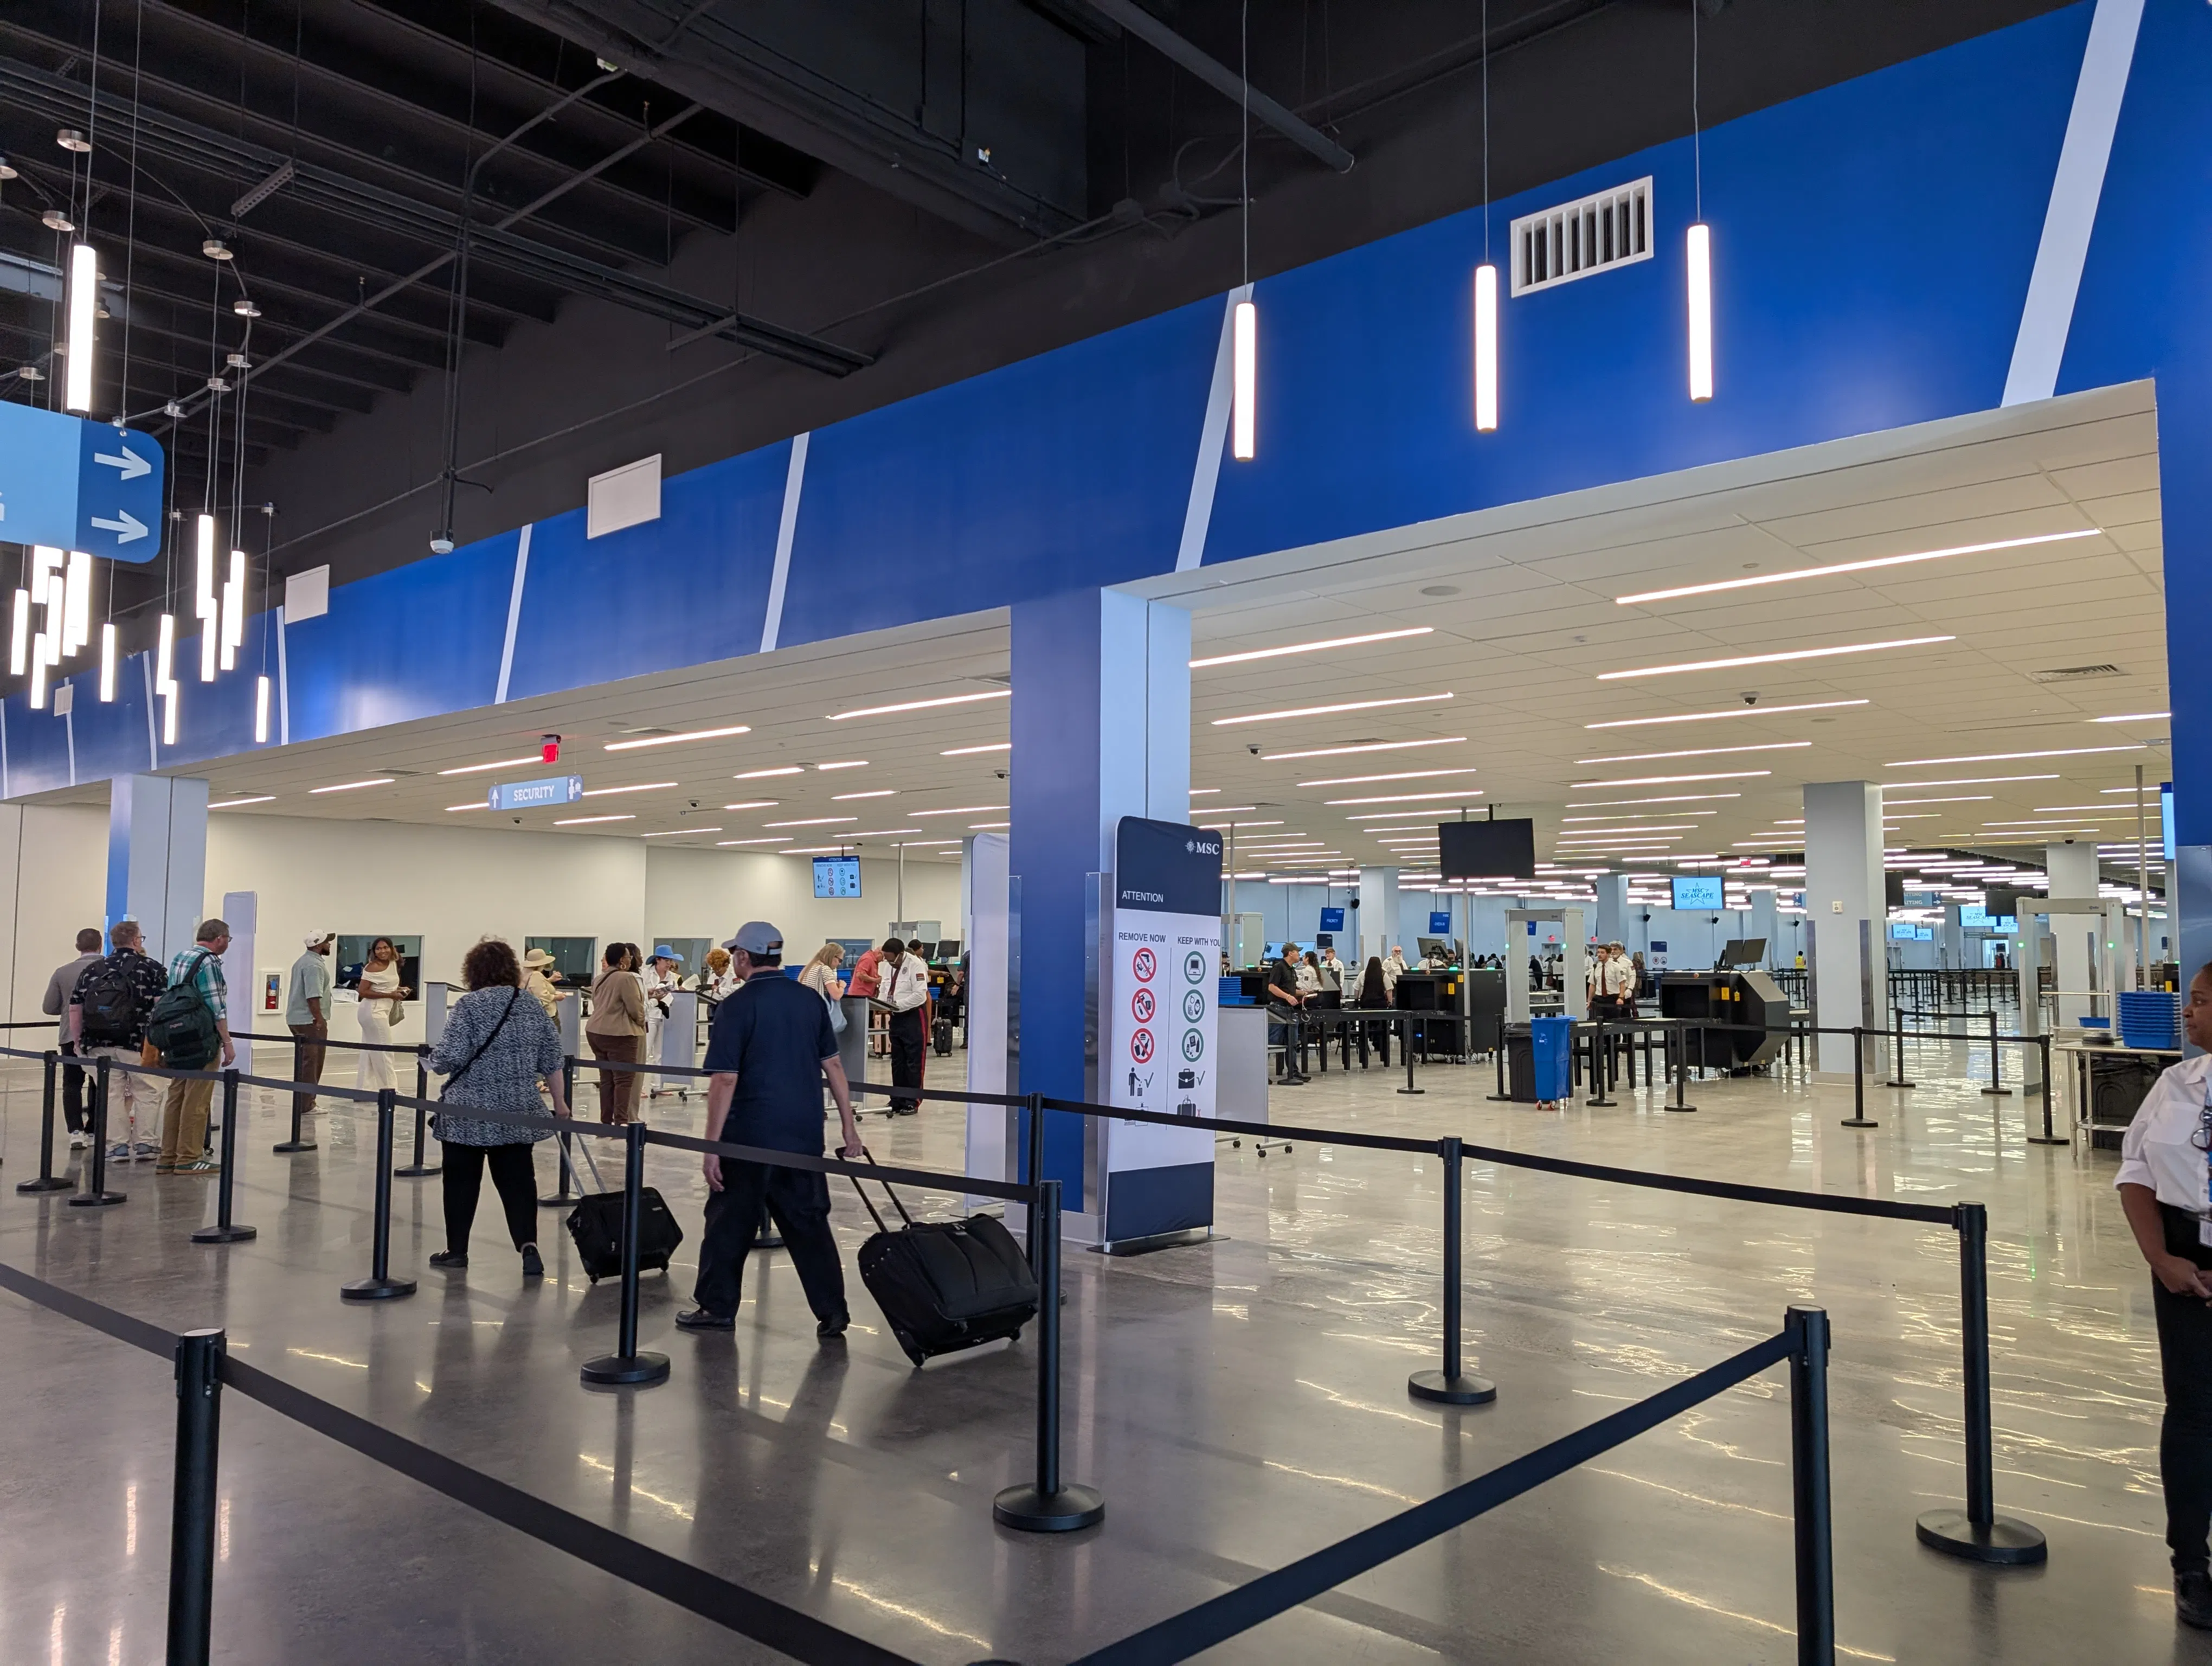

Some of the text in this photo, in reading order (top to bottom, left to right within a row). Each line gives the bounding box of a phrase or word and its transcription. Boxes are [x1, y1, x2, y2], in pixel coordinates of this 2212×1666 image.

[513, 785, 555, 802] SECURITY
[1196, 842, 1220, 855] MSC
[1122, 890, 1163, 902] ATTENTION
[1118, 932, 1166, 943] REMOVE NOW
[1177, 936, 1193, 945] KEEP
[1194, 937, 1209, 946] WITH
